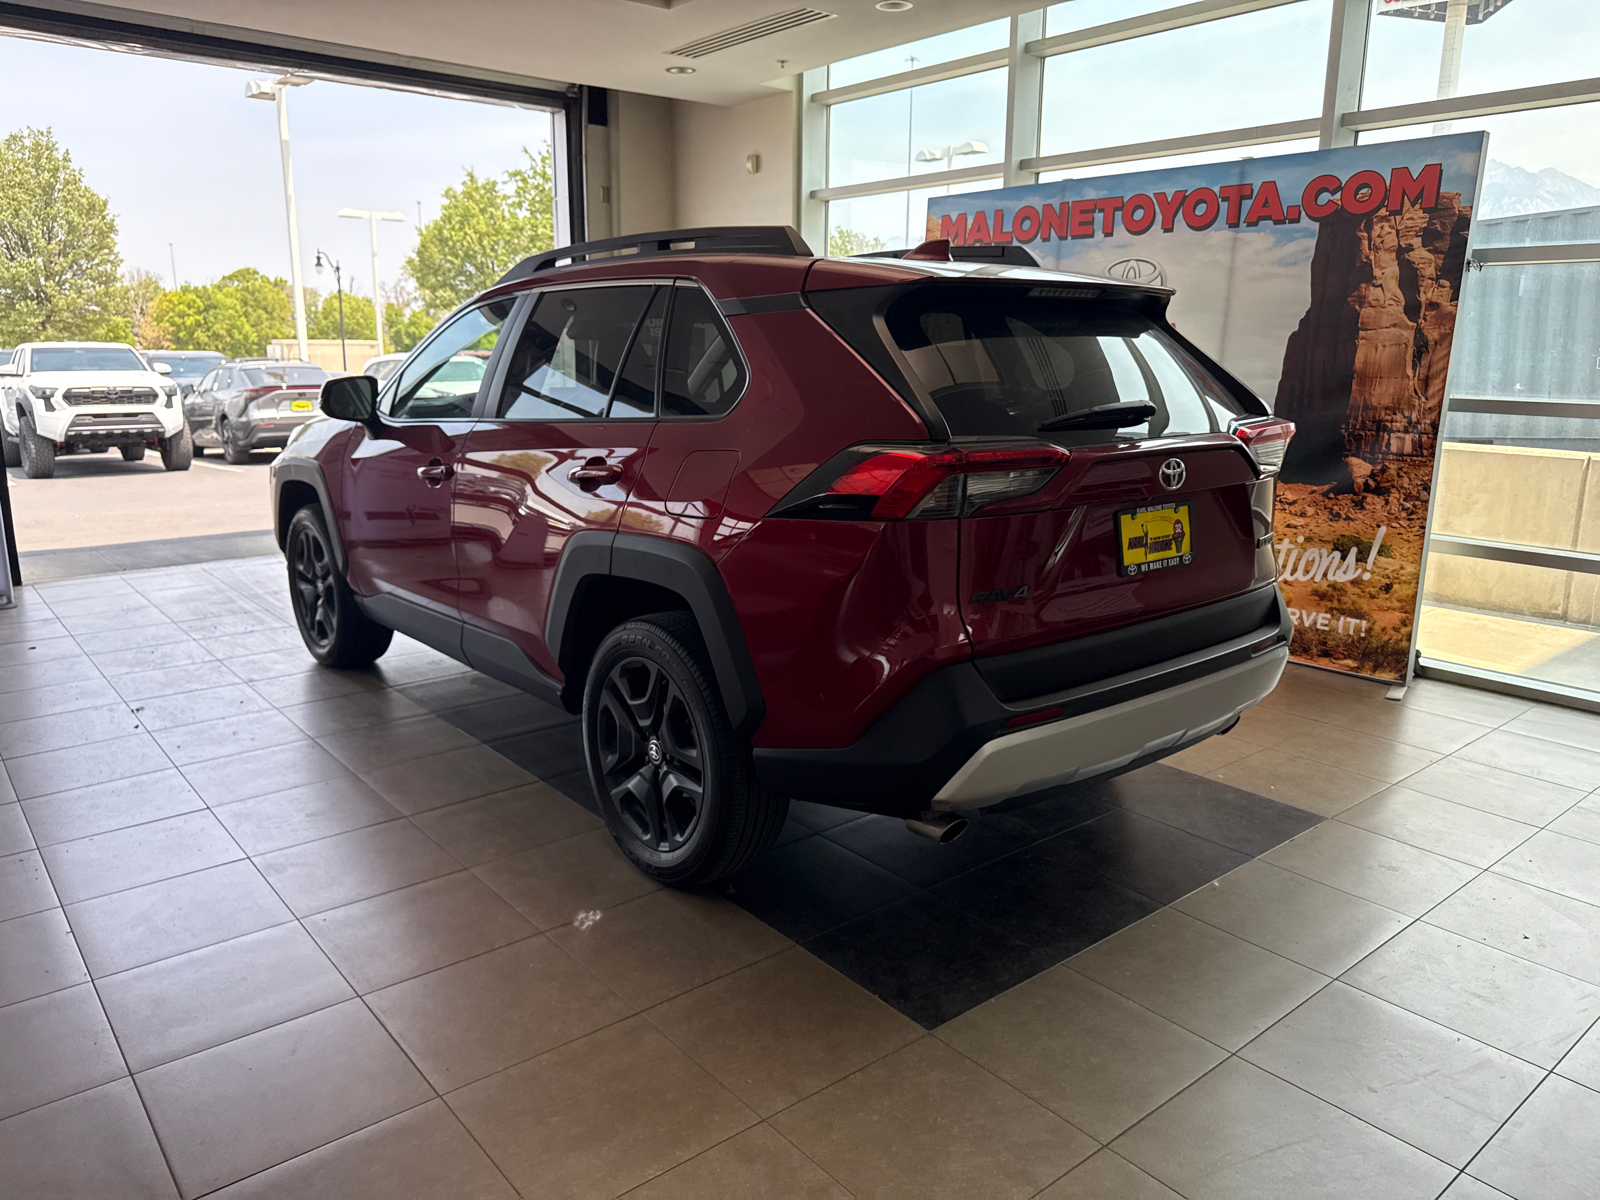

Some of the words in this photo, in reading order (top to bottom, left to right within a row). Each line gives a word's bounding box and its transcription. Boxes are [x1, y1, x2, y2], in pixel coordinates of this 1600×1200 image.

[940, 163, 1443, 246] MALONETOYOTA.COM
[1175, 524, 1182, 533] 32
[1141, 563, 1149, 572] WE
[1149, 560, 1162, 570] MAKE
[1163, 559, 1168, 567] IT
[1168, 557, 1180, 566] EASY
[969, 585, 1030, 604] RAV4
[1338, 616, 1367, 637] IT!
[621, 634, 651, 647] OPEN
